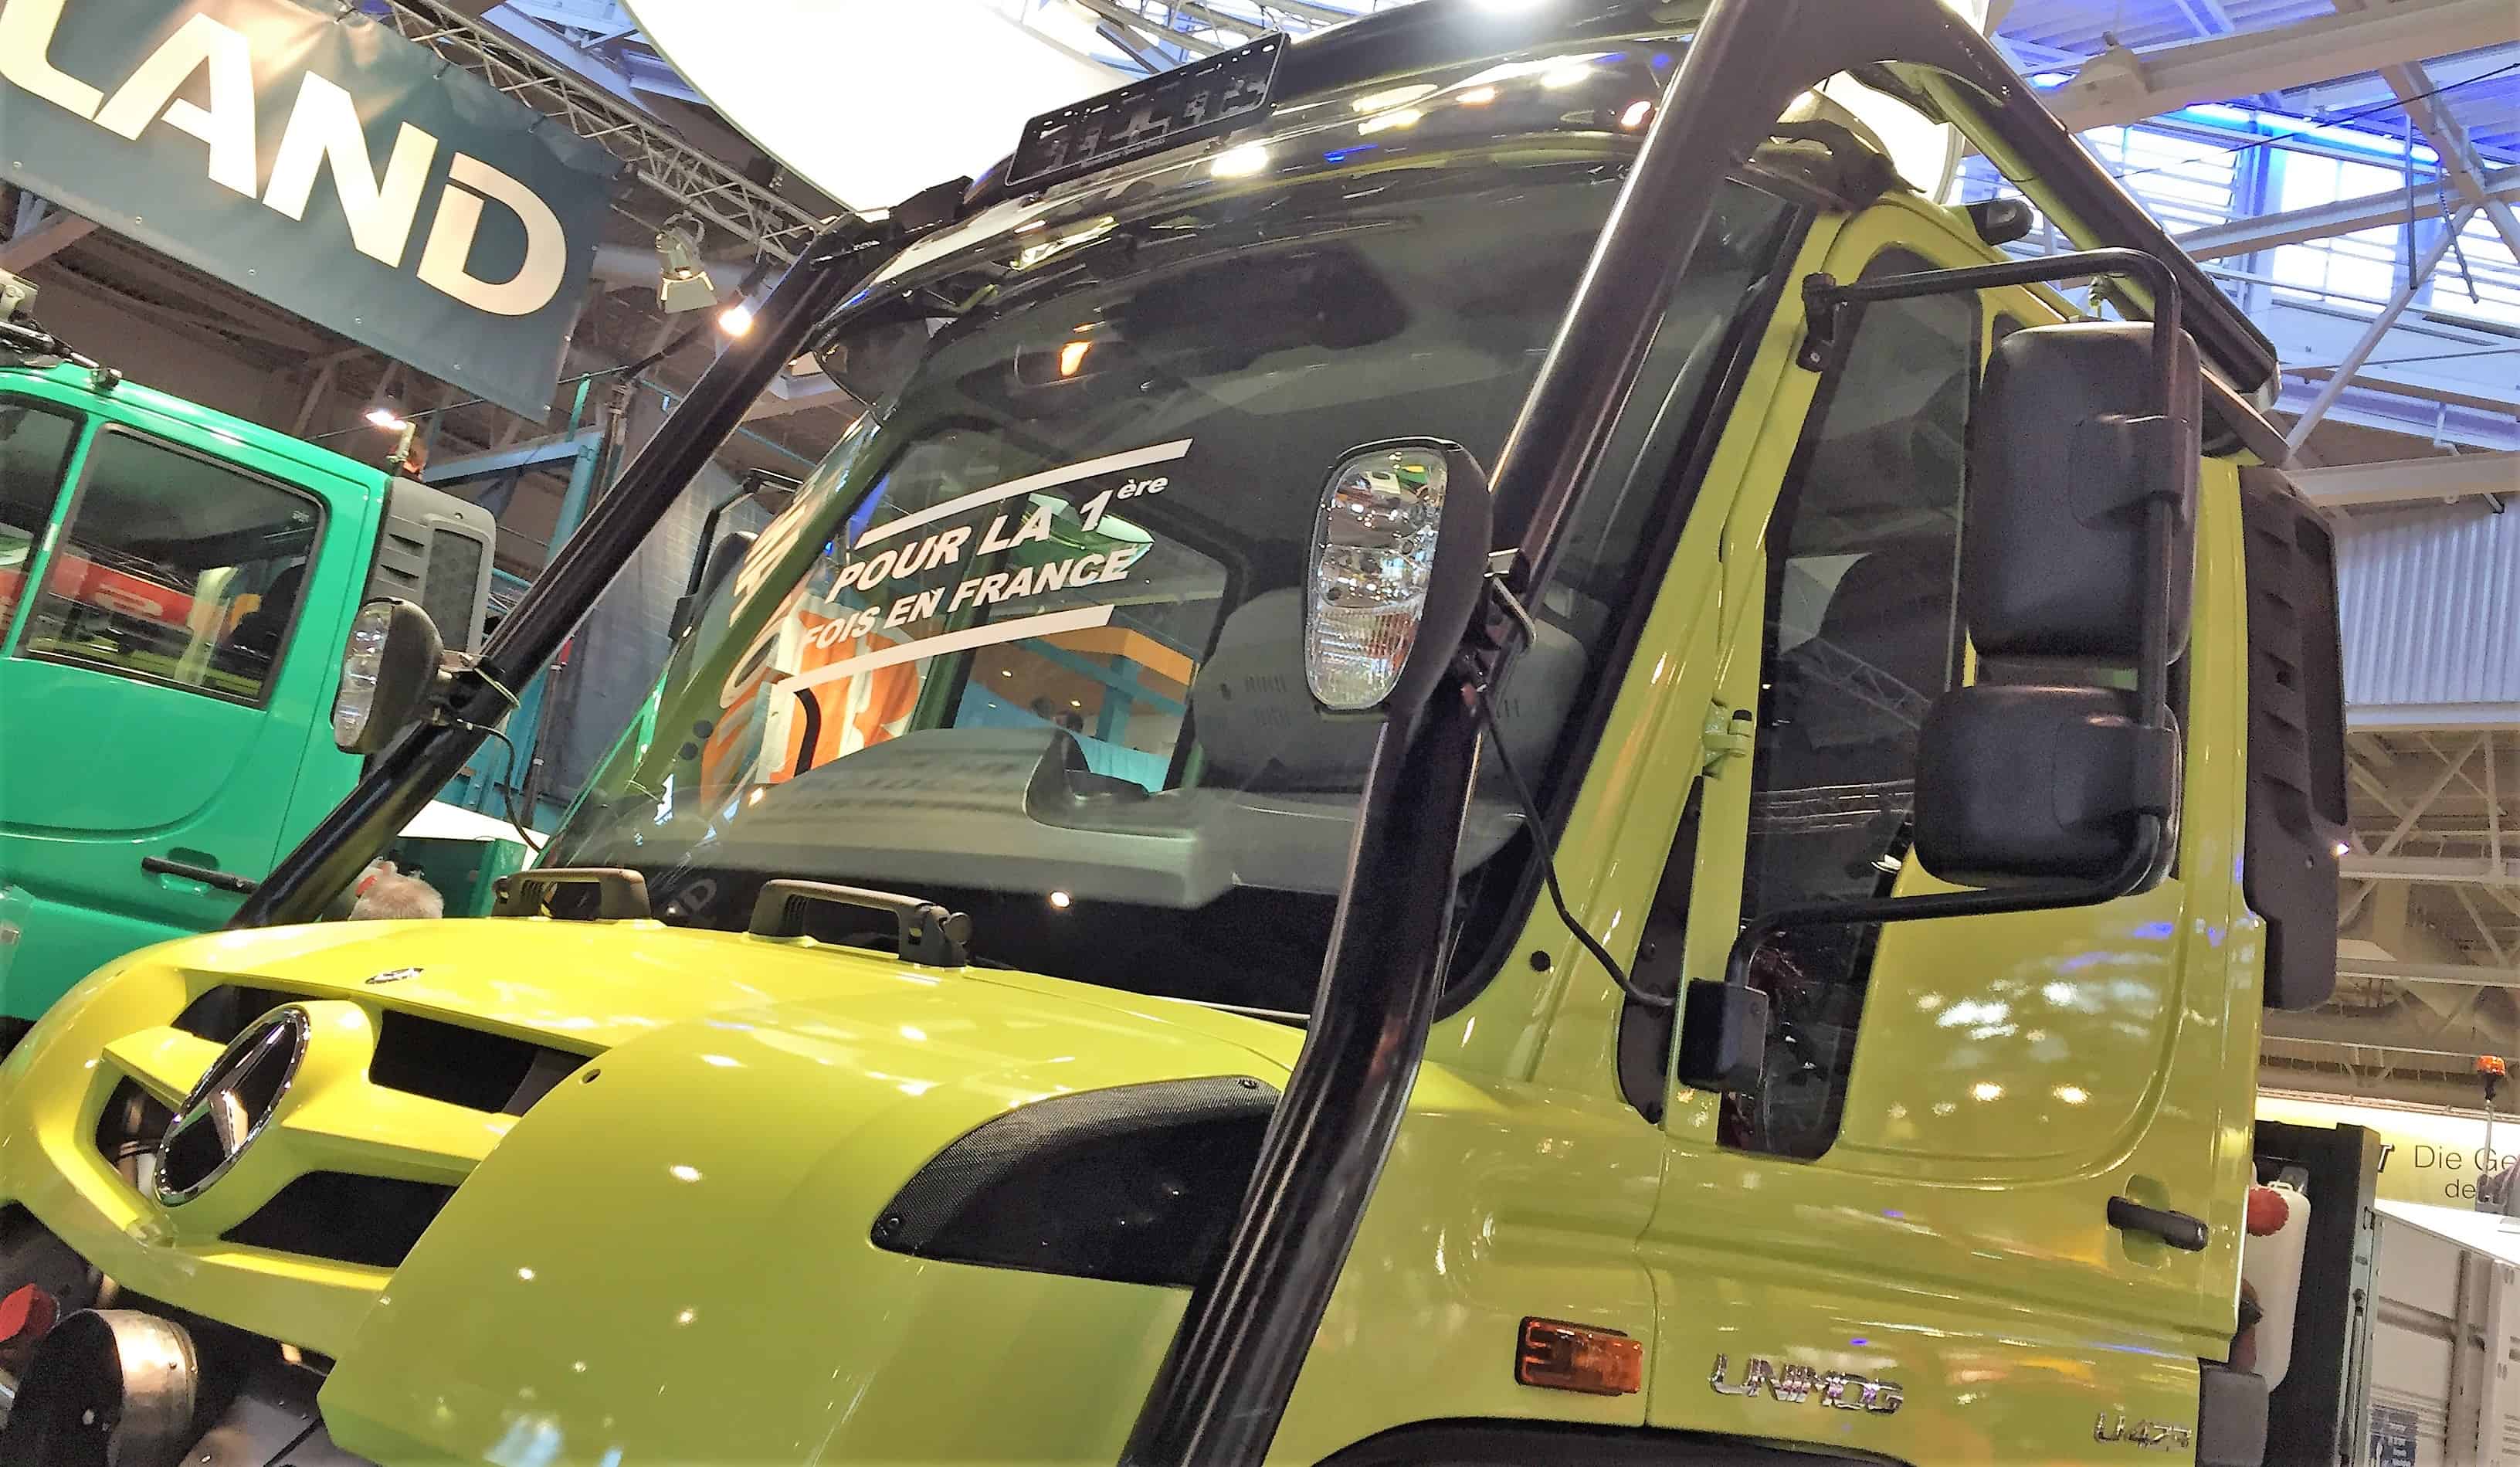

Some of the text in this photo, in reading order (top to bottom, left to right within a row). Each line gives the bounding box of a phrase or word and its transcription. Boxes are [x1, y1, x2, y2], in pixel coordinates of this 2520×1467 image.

[825, 525, 972, 604] POUR
[975, 505, 1053, 556] LA
[797, 545, 1139, 650] FOIS EN FRANCE
[2415, 1145, 2462, 1170] Die
[1708, 1353, 1904, 1415] UNIMOG
